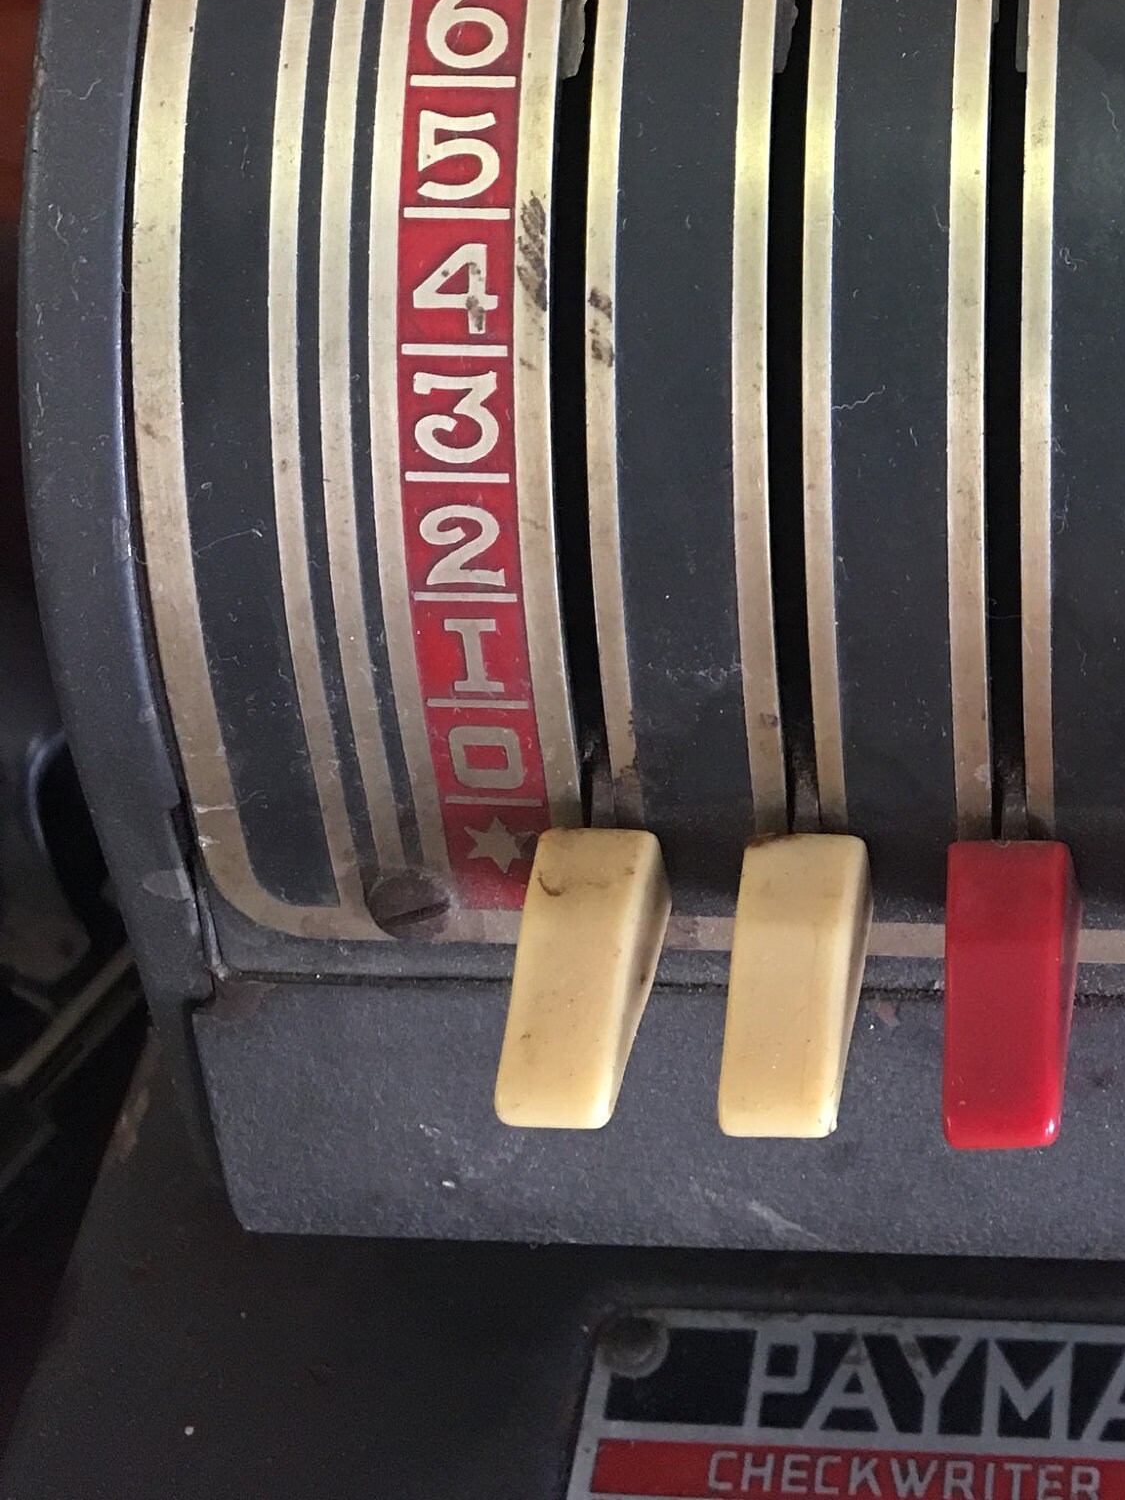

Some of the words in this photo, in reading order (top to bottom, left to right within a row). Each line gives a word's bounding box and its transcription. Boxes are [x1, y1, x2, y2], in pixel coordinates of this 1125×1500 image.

[417, 110, 500, 200] 5
[413, 243, 498, 334] 4
[413, 370, 500, 464] 3
[419, 505, 506, 587] 2
[707, 1449, 1100, 1500] CHECKWRITER
